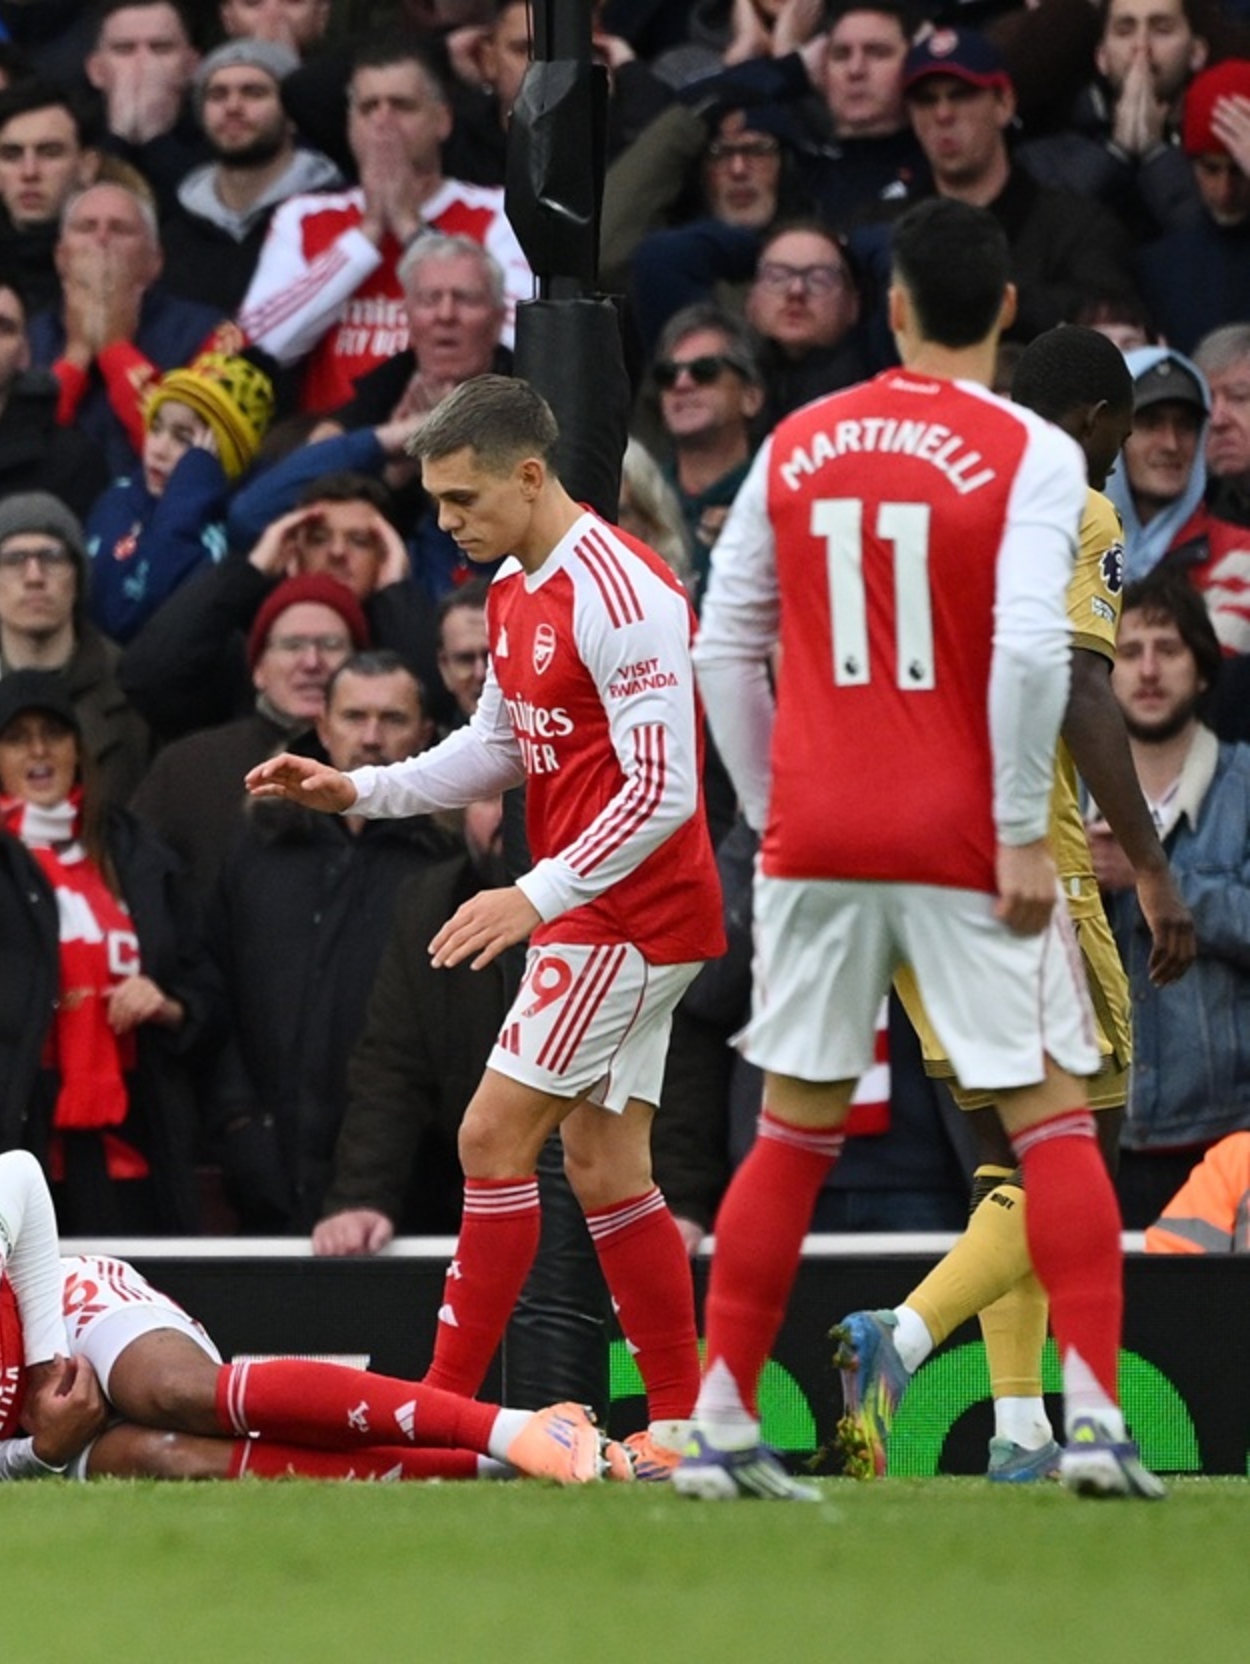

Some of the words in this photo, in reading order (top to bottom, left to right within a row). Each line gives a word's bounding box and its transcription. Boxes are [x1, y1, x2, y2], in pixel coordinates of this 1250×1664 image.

[779, 417, 996, 495] MARTINELLI
[810, 497, 936, 690] 11
[608, 672, 679, 699] RWANDA
[617, 658, 658, 680] VISIT
